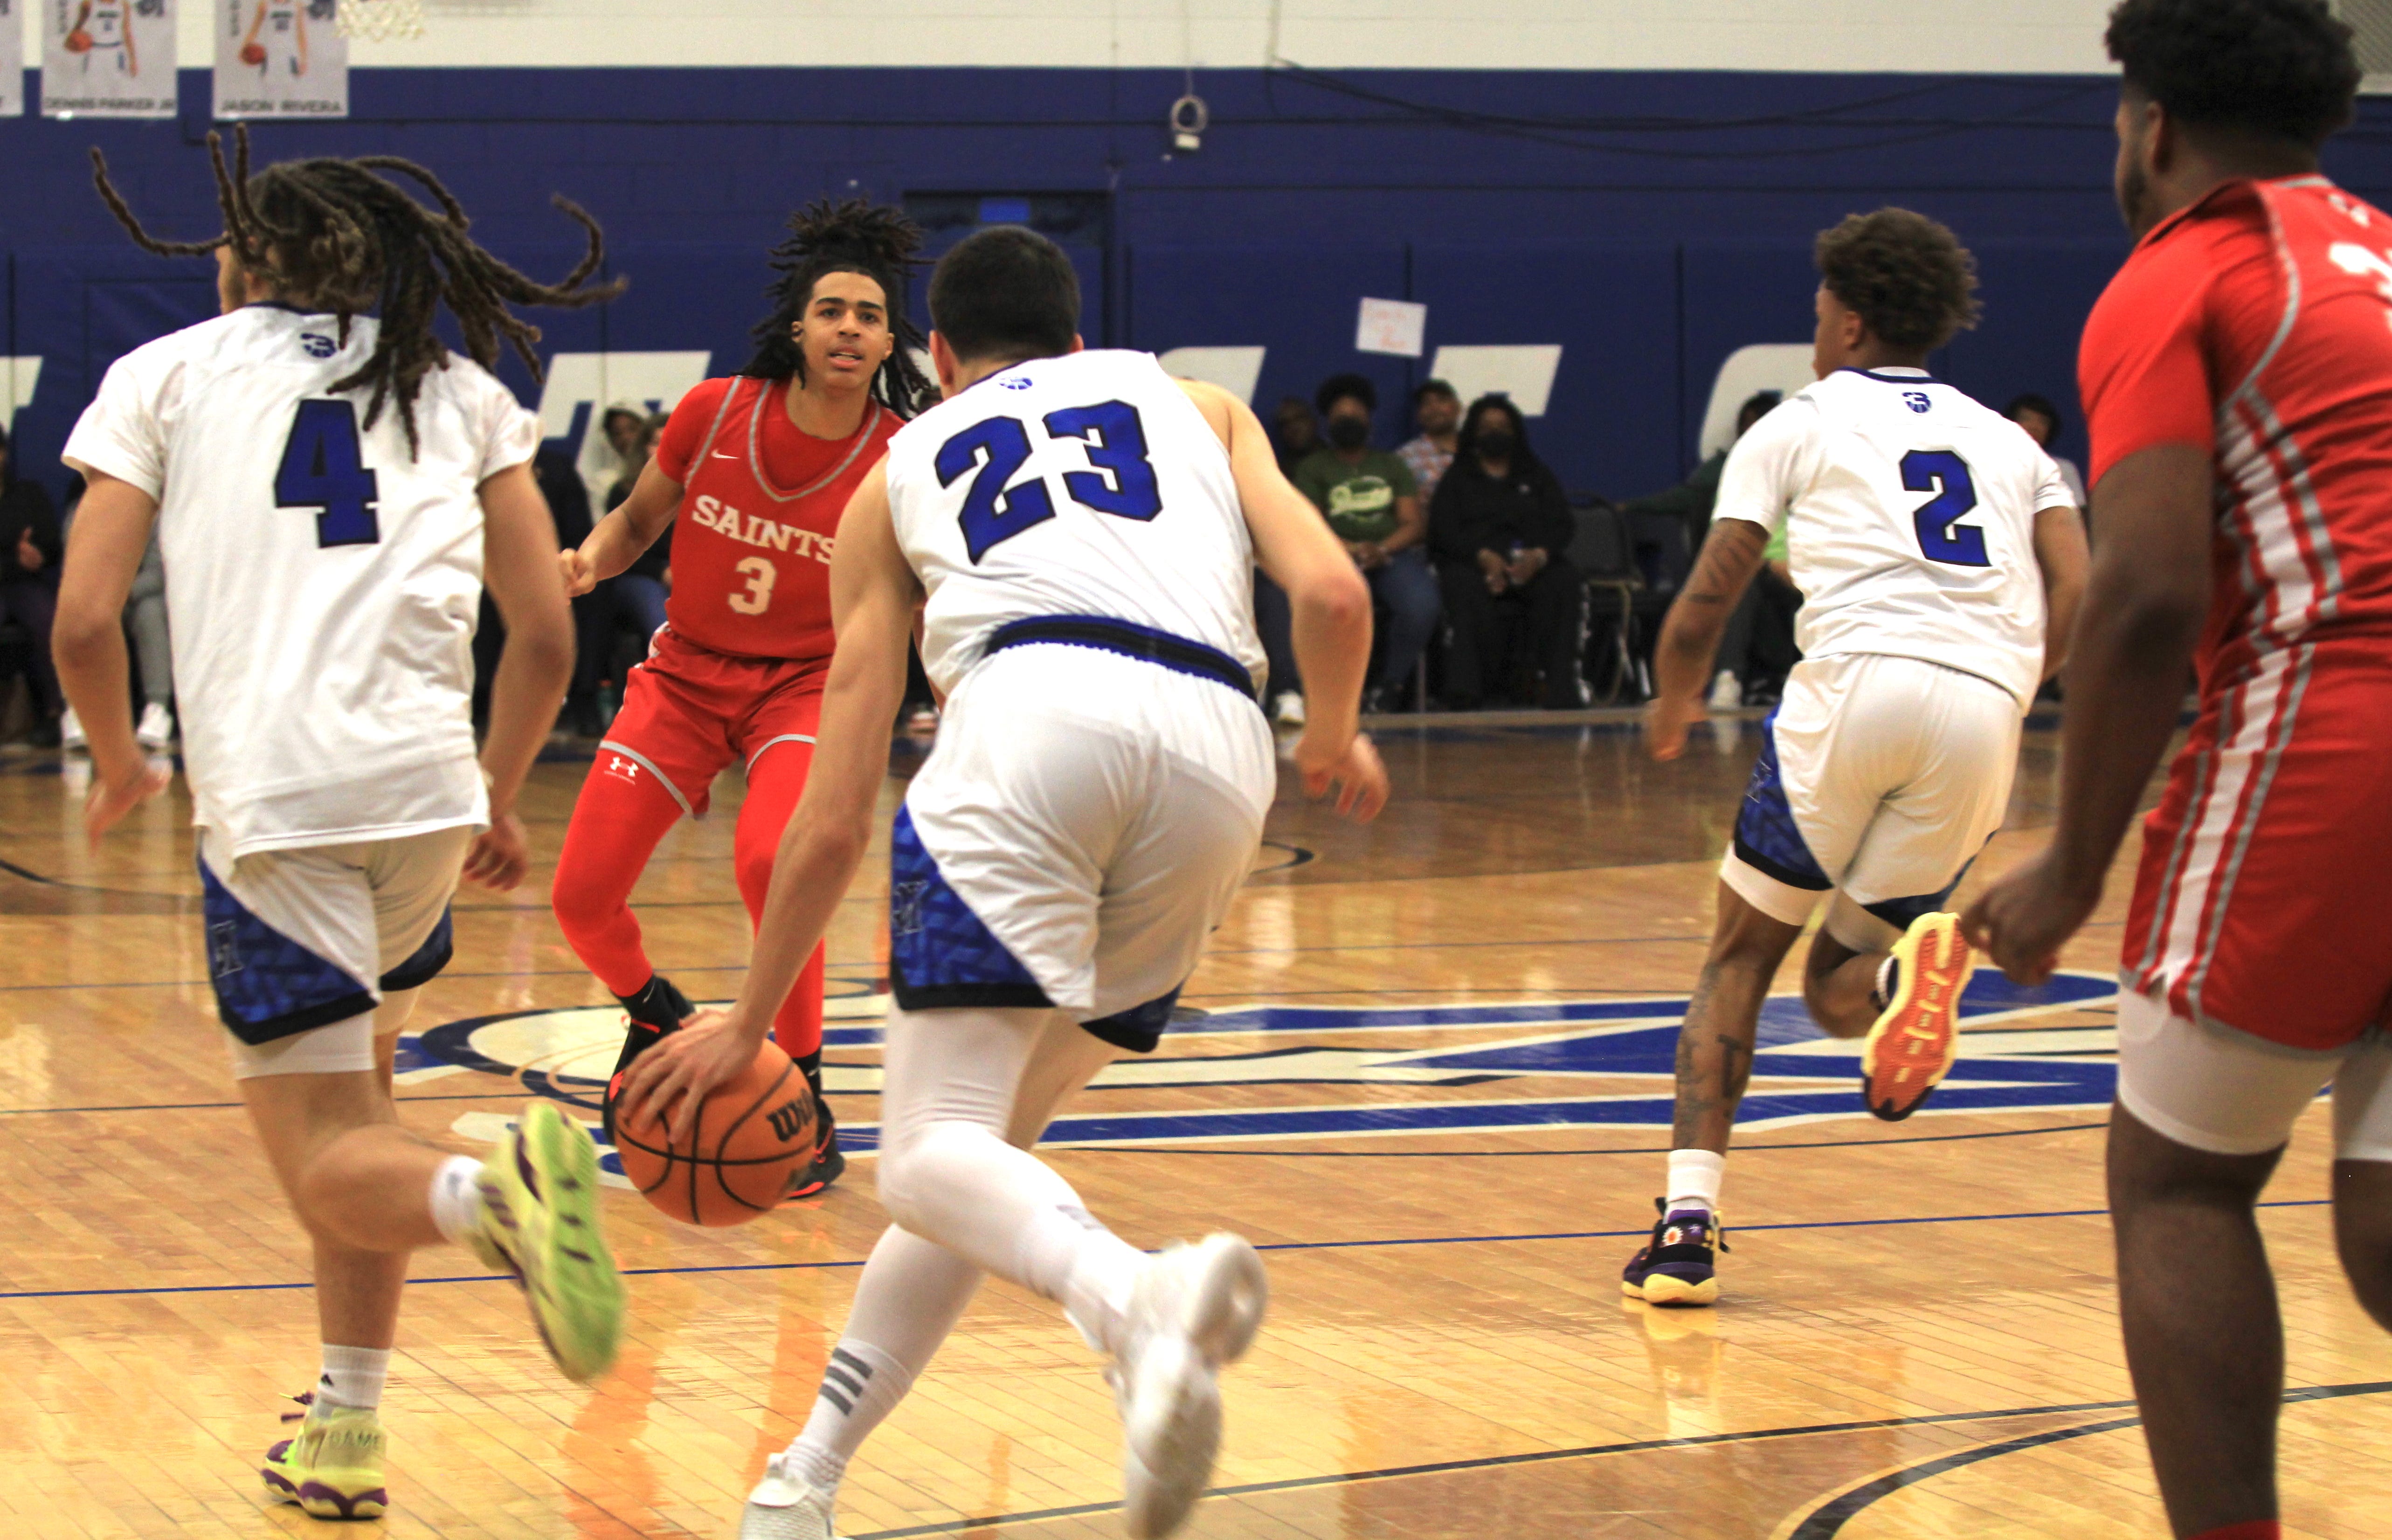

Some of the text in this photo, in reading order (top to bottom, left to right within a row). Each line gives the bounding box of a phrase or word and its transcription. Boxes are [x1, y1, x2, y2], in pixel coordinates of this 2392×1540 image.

[221, 99, 341, 112] JASON RIVERA
[273, 398, 380, 548] 4
[934, 399, 1164, 566] 23
[1899, 449, 1992, 567] 2
[691, 494, 835, 565] SAINTS
[728, 556, 777, 616] 3
